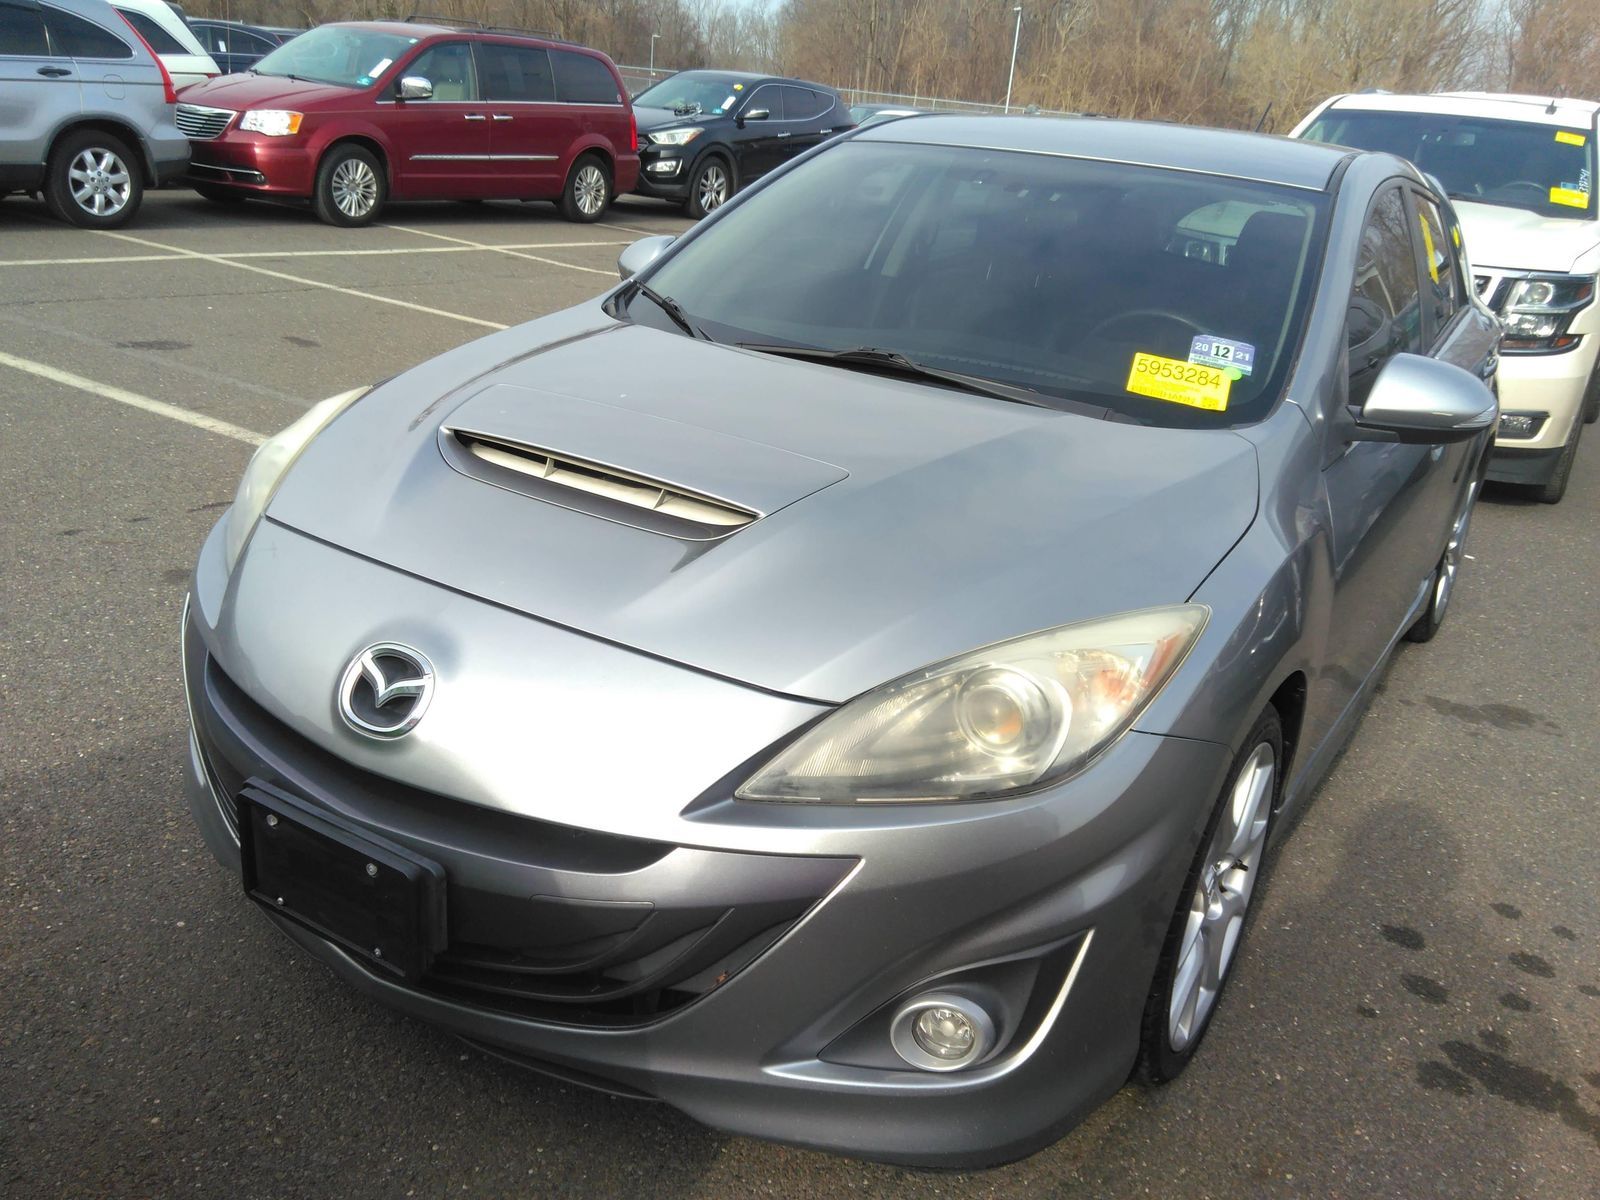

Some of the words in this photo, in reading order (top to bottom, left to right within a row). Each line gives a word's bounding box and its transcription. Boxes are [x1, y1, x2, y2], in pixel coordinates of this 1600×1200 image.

[1194, 342, 1209, 352] 20
[1213, 345, 1230, 359] 12
[1235, 351, 1250, 361] 21
[1136, 358, 1221, 389] 5953284
